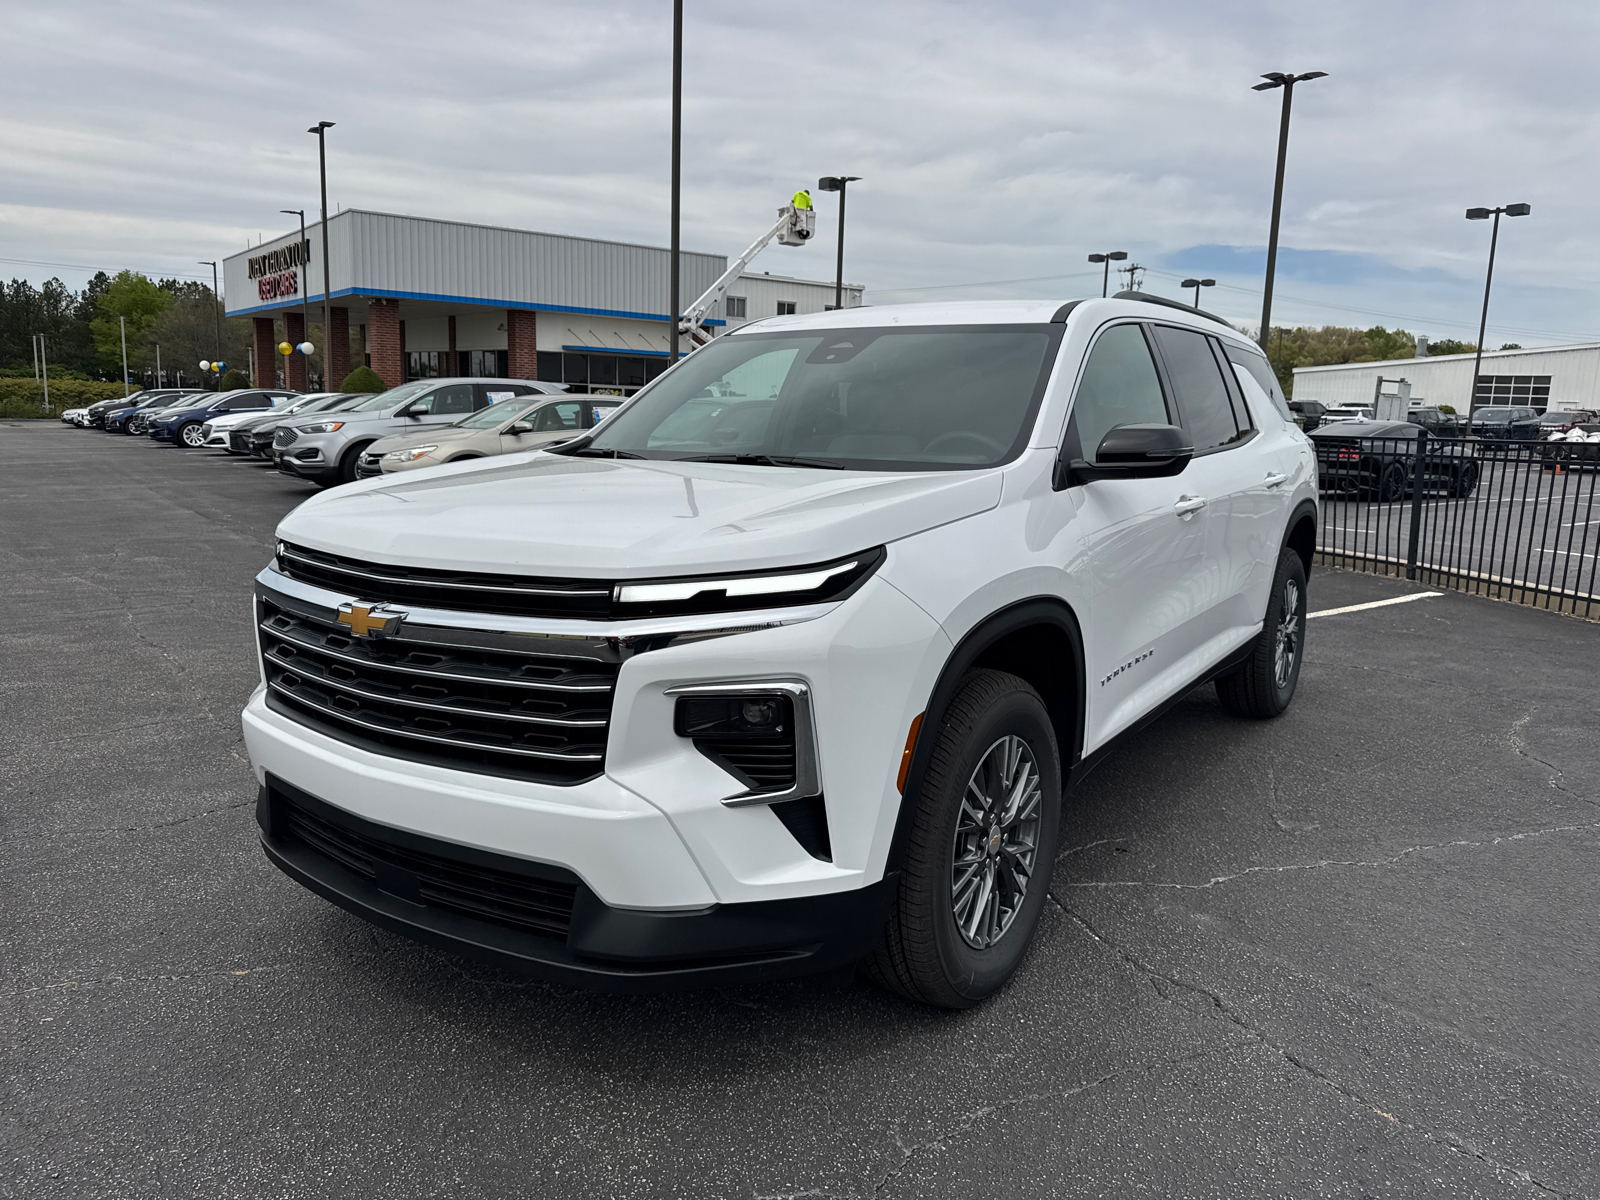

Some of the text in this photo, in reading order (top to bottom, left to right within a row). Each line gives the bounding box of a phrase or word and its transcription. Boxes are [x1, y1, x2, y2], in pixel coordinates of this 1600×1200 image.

[247, 254, 266, 279] JOHN
[258, 270, 297, 300] USED CARS
[1100, 647, 1155, 687] TRAVERSE
[934, 755, 969, 872] BRIDGESTONE
